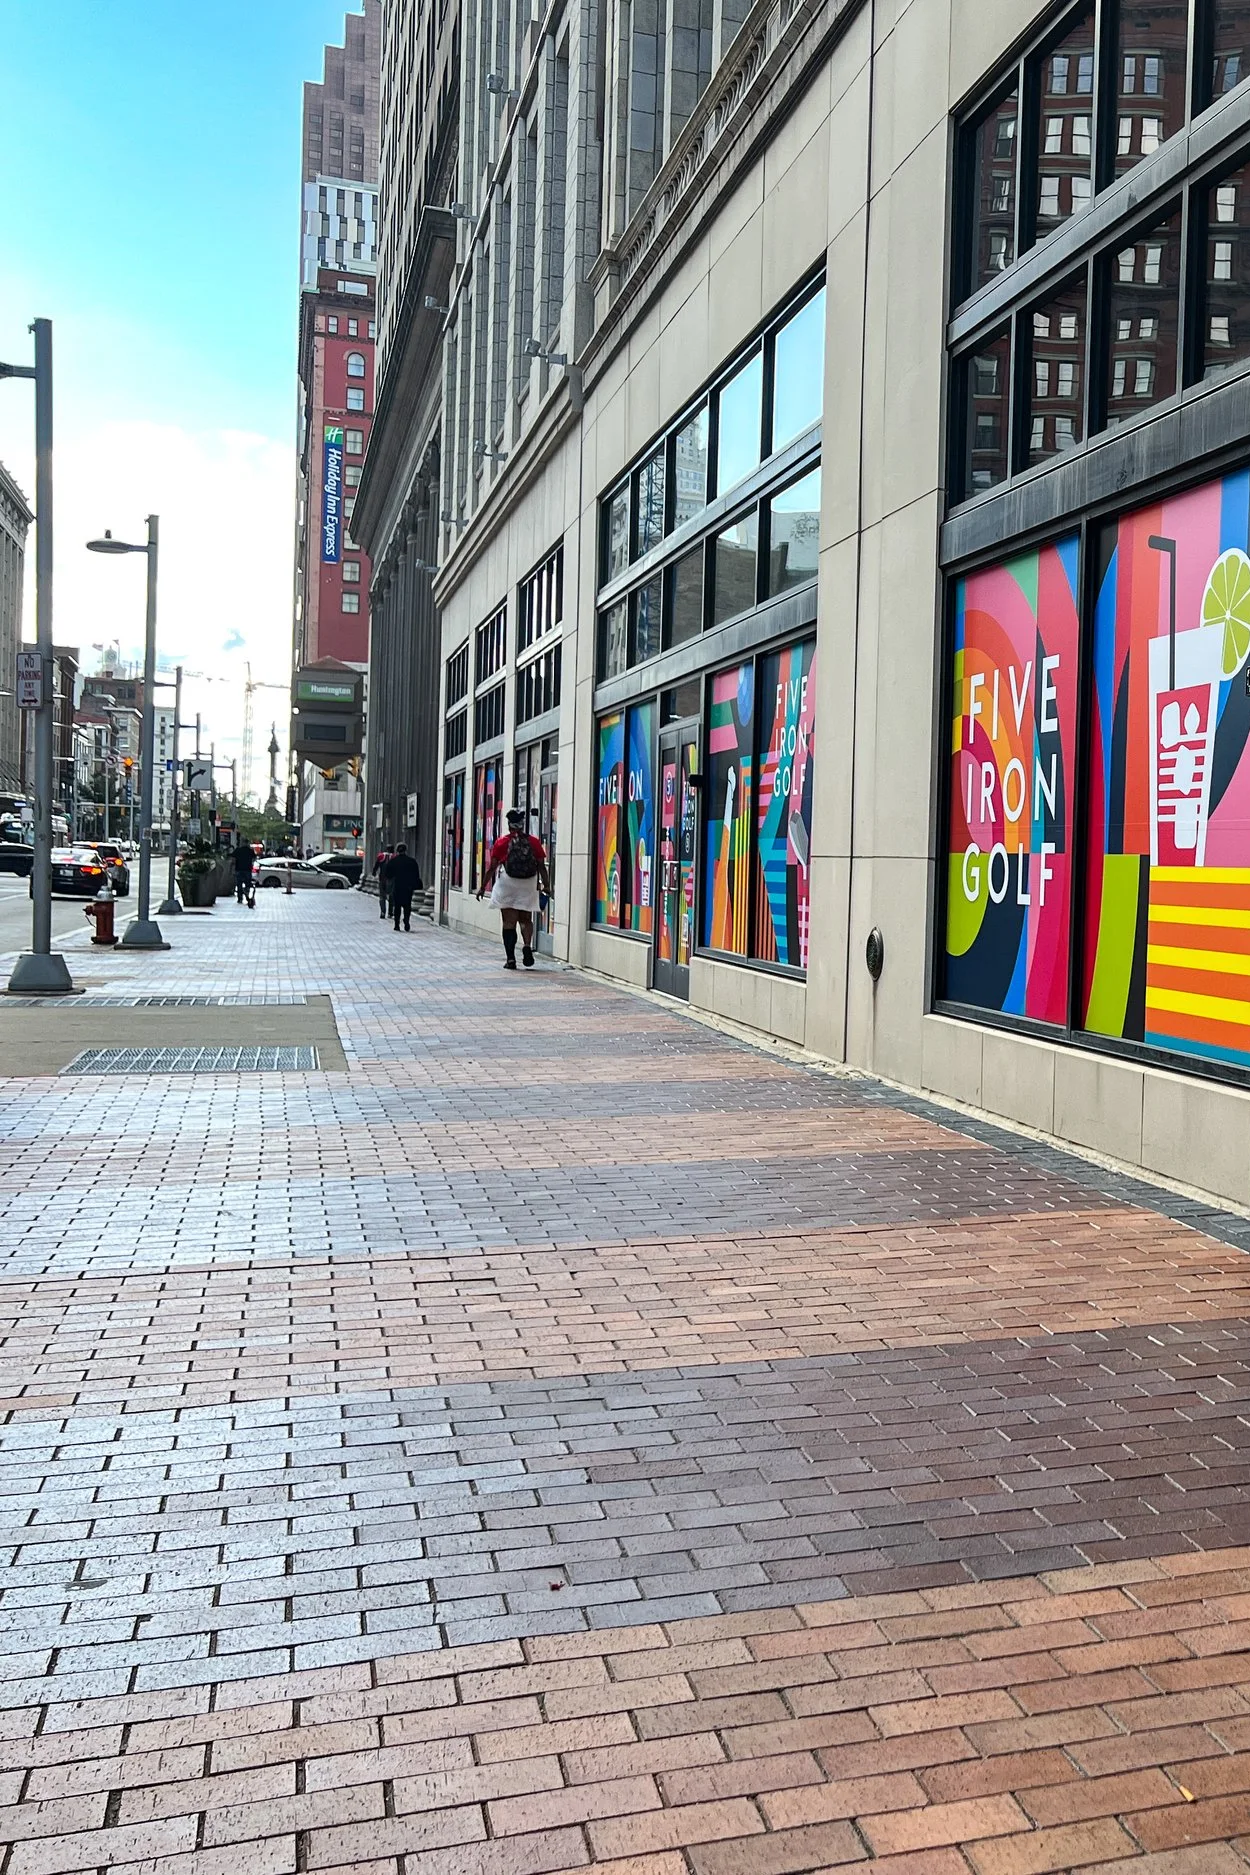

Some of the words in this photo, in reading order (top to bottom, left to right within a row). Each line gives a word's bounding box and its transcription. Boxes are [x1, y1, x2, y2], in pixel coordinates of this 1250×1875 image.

[324, 448, 342, 492] Holiday
[326, 494, 341, 515] Inn
[323, 515, 339, 557] Express
[24, 658, 35, 668] NO
[311, 684, 351, 696] Huntington
[776, 675, 808, 719] FIVE
[968, 653, 1060, 744] FIVE
[775, 722, 808, 758] IRON
[599, 775, 618, 806] FIVE
[773, 763, 806, 797] GOLF
[966, 753, 1057, 824] IRON
[962, 842, 1056, 907] GOLF
